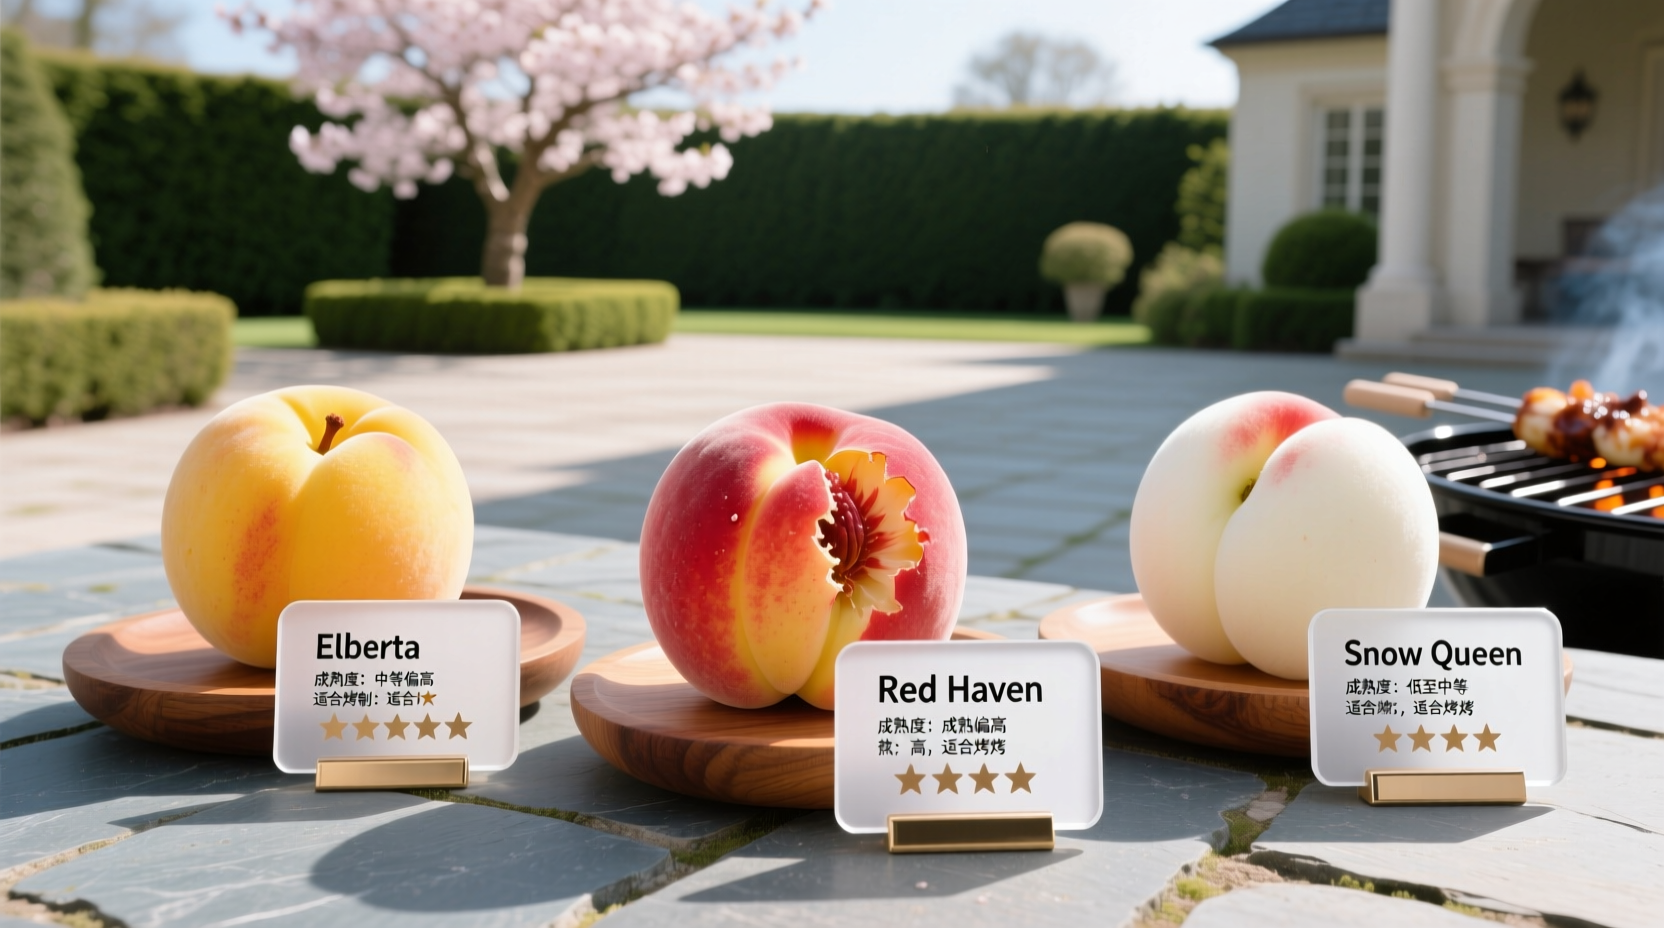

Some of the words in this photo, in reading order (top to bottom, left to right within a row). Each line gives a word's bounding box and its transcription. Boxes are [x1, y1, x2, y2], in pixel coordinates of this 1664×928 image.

[316, 632, 420, 660] Elberta
[1345, 639, 1423, 667] Snow
[1431, 639, 1522, 671] Queen
[879, 674, 937, 704] Red
[948, 675, 1043, 703] Haven
